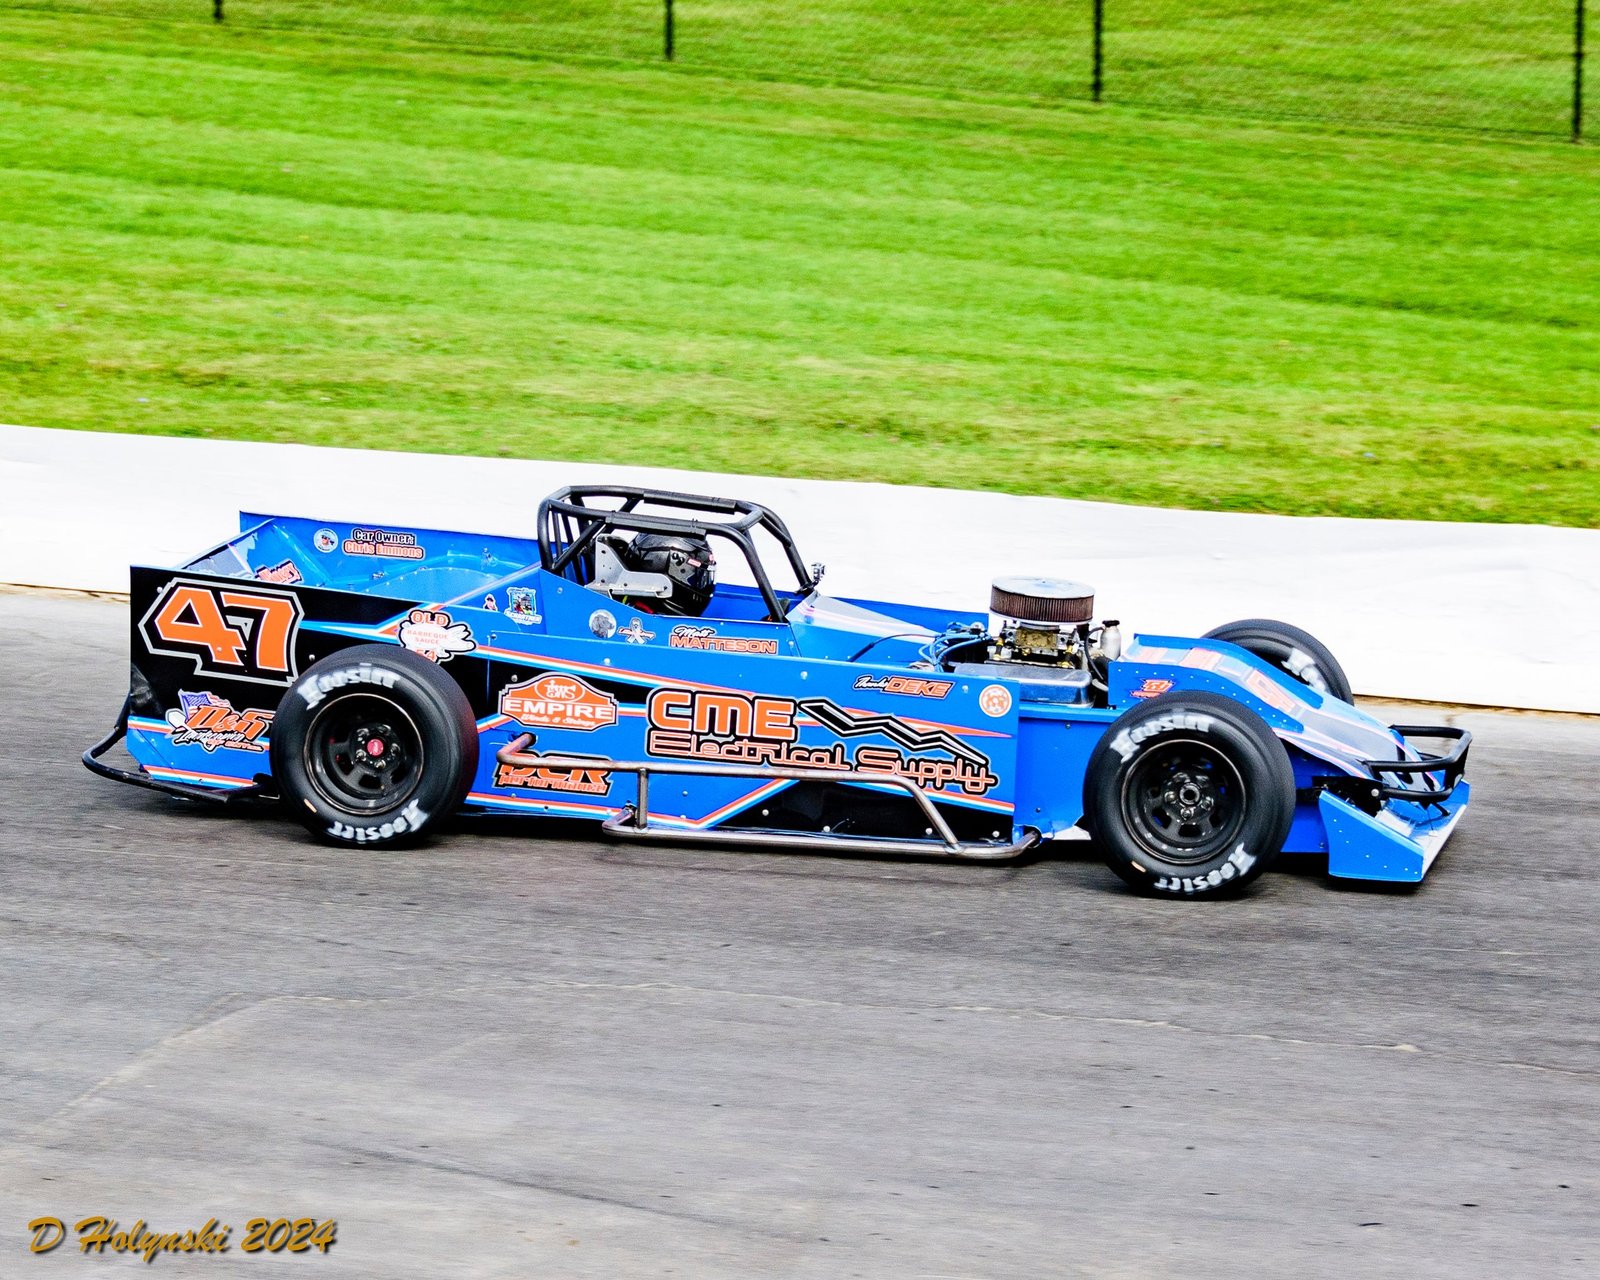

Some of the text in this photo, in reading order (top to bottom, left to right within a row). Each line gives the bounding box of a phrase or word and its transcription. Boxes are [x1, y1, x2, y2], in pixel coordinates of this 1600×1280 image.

[354, 530, 414, 545] Car Owner:
[344, 540, 375, 554] Chris
[376, 543, 422, 559] Emmons
[411, 611, 447, 626] OLD
[153, 585, 296, 673] 47
[674, 626, 714, 638] Matt
[670, 635, 777, 654] MATTESON
[885, 677, 952, 698] DEKE
[504, 700, 614, 720] EMPIRE
[650, 691, 796, 741] CME
[649, 730, 996, 793] Electrical Supply
